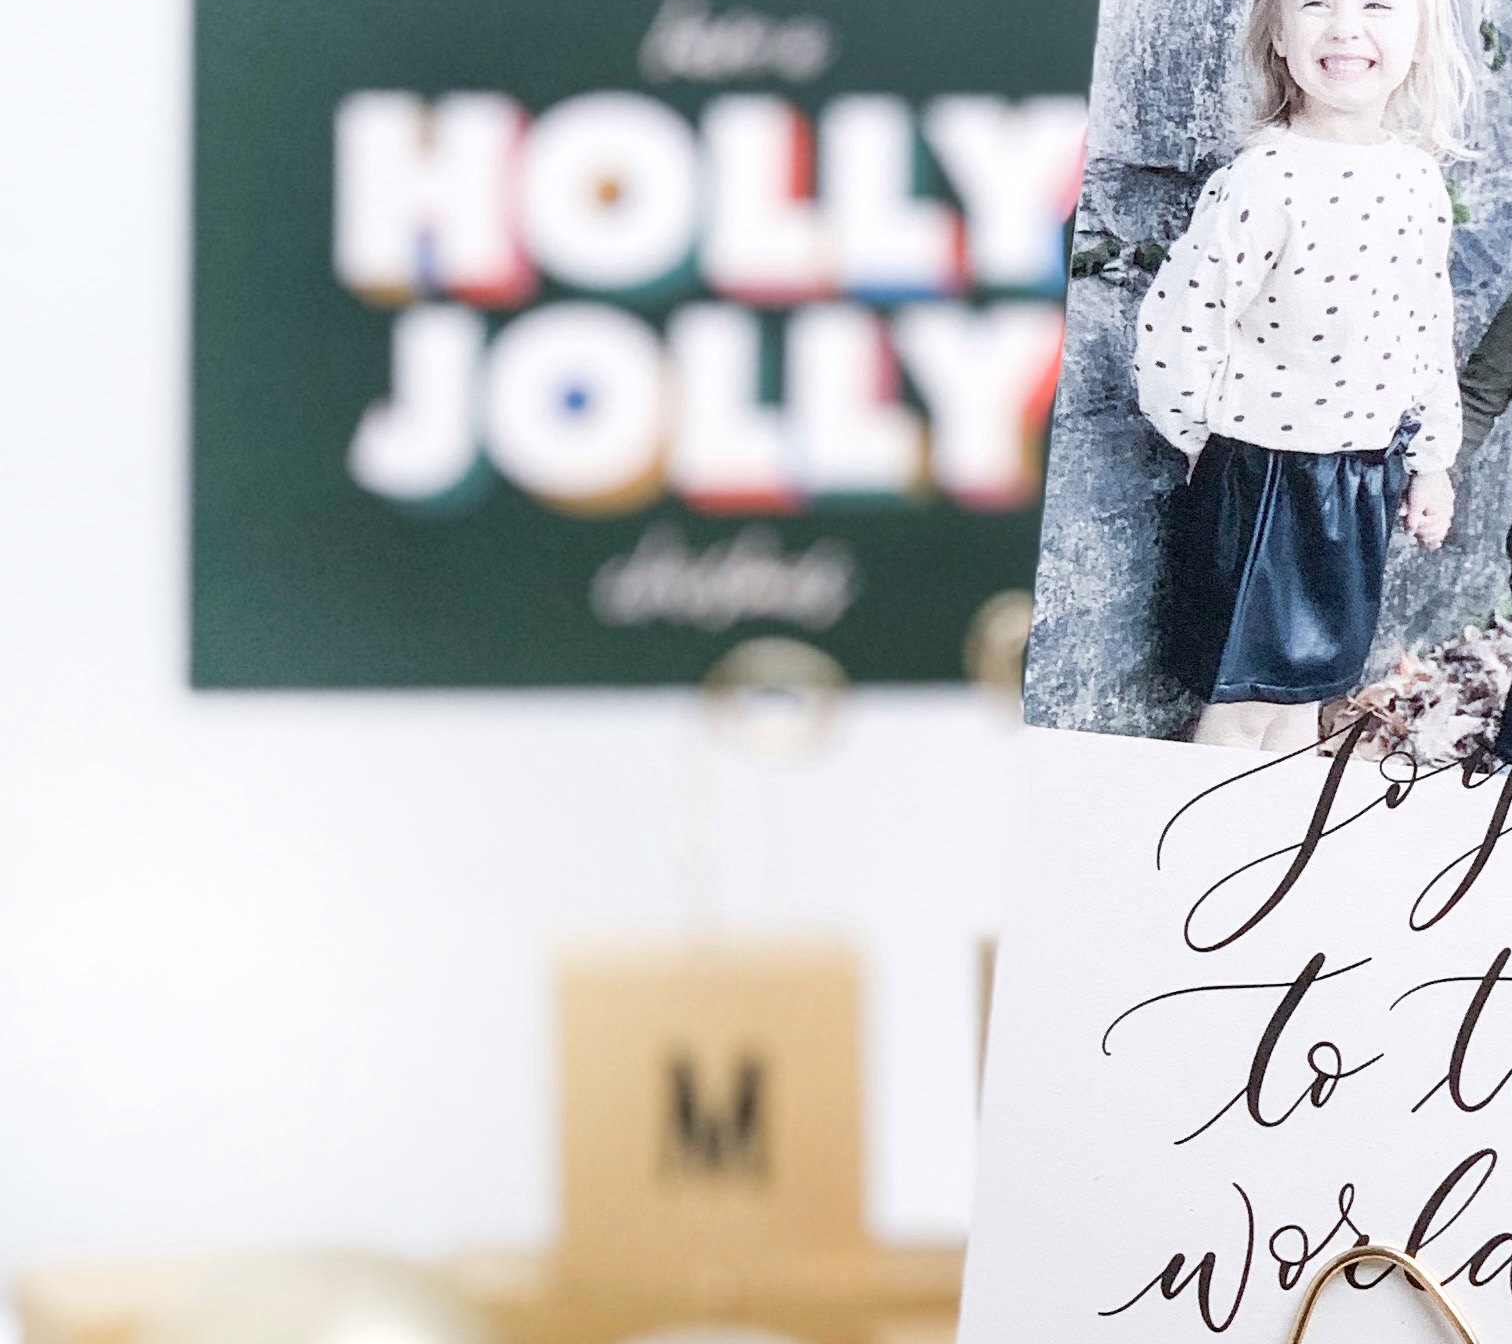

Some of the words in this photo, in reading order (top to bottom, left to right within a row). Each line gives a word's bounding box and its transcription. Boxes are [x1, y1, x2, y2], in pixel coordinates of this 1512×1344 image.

[332, 86, 1090, 306] HOLLY
[346, 299, 1064, 516] JOLLY
[660, 1041, 774, 1182] M
[1101, 951, 1384, 1146] to
